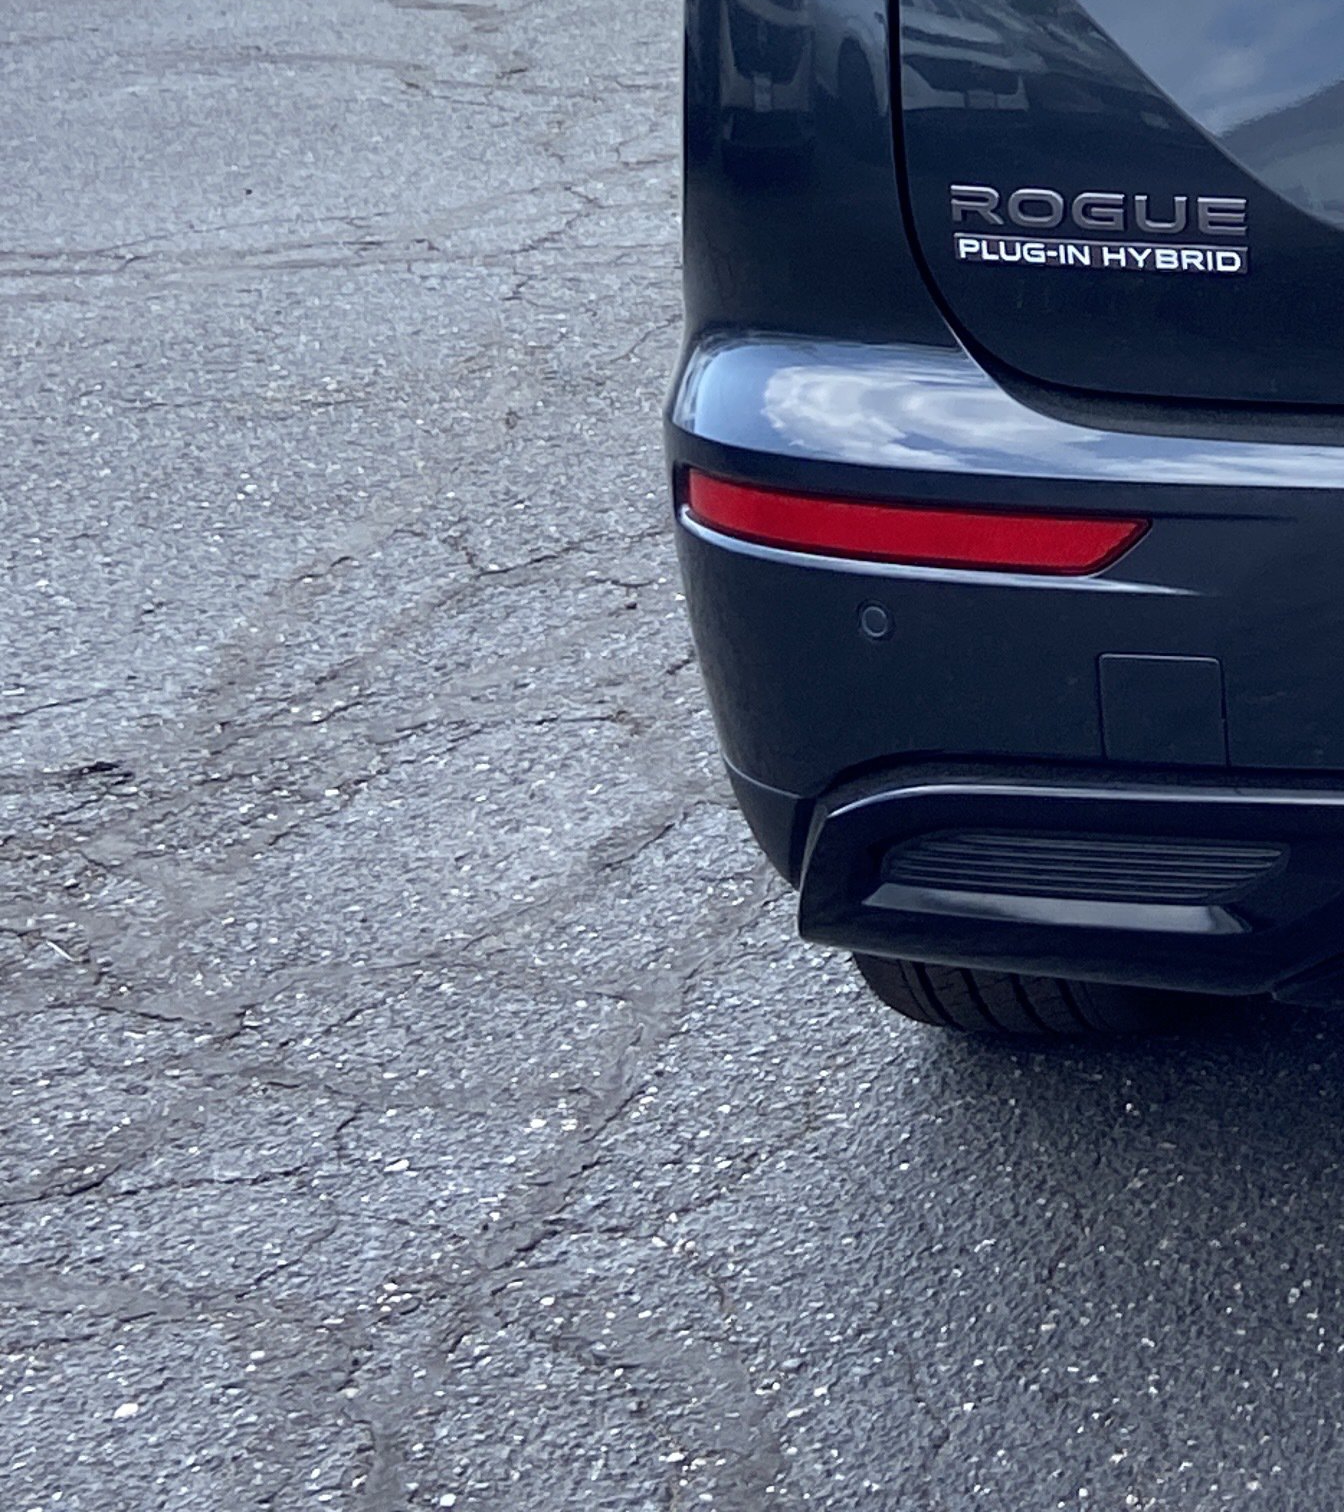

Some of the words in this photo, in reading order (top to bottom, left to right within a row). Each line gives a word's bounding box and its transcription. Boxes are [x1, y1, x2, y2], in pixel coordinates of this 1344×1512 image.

[951, 184, 1247, 236] ROGUE
[958, 238, 1091, 266] PLUG-IN
[1102, 246, 1241, 273] HYBRID
